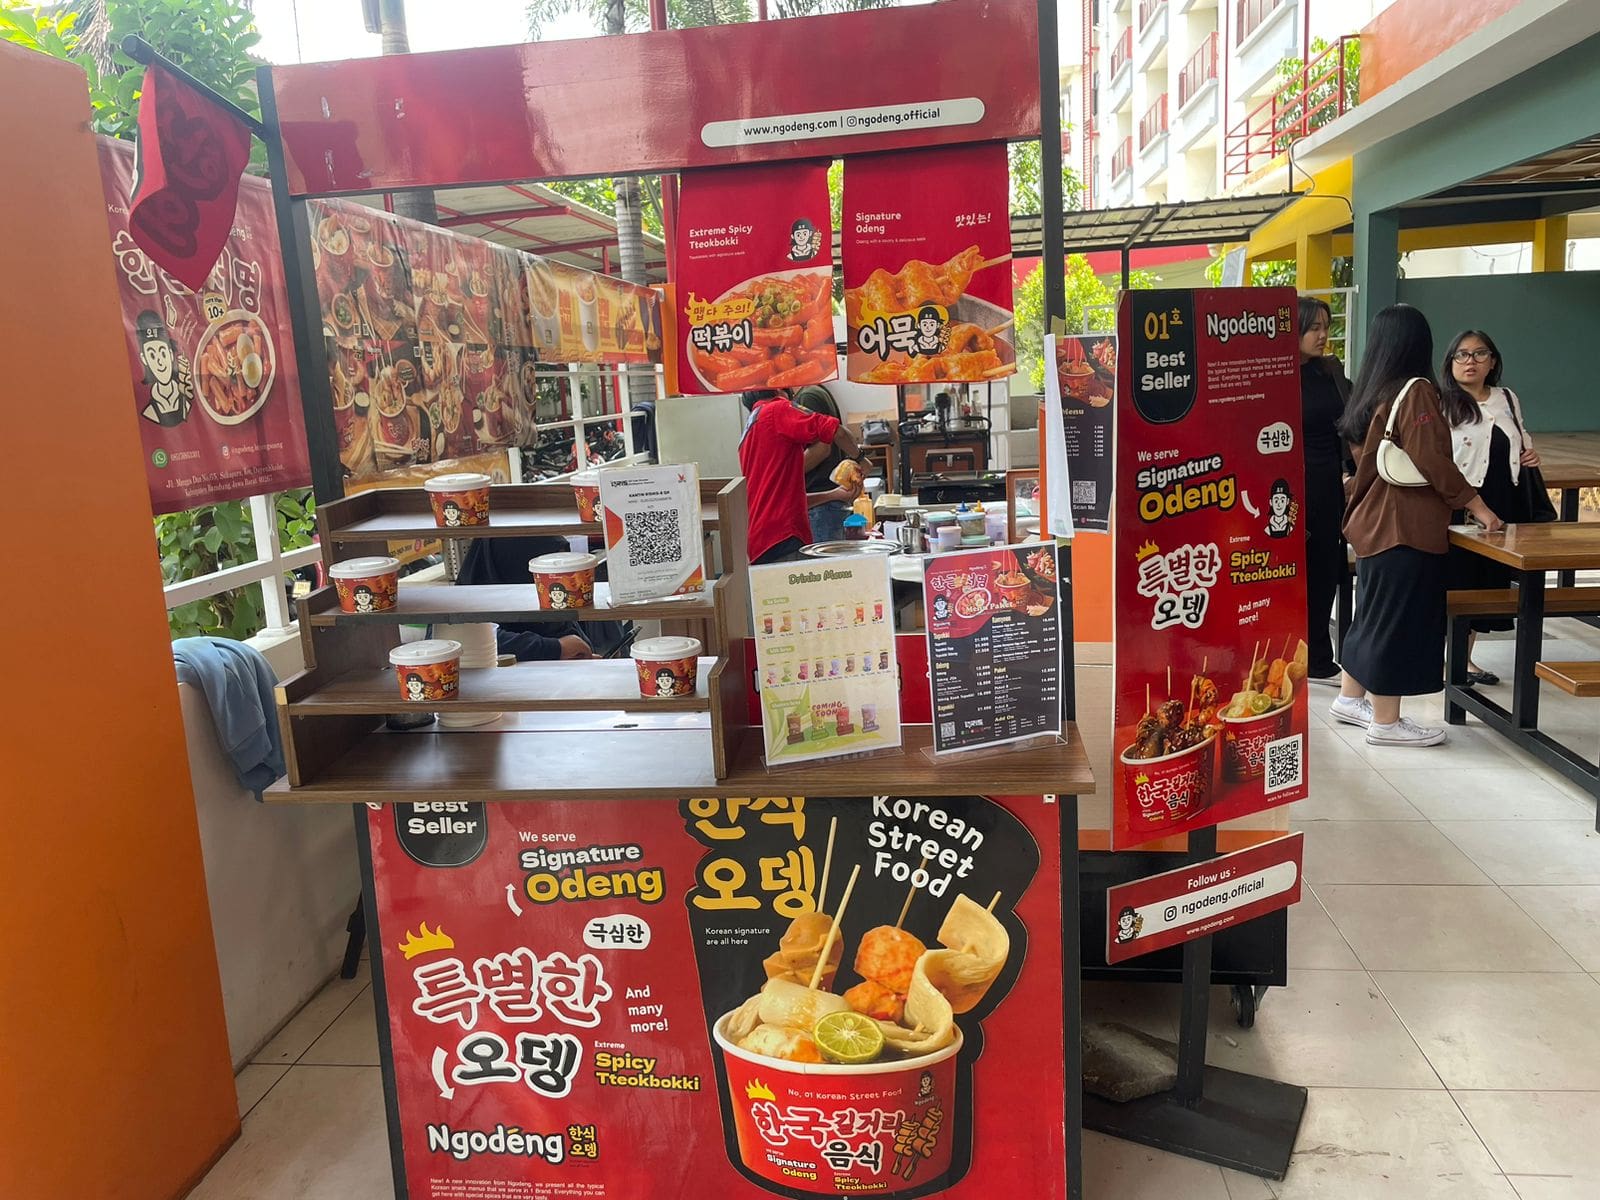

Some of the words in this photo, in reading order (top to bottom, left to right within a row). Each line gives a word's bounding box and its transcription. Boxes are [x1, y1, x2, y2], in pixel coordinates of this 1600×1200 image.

[744, 121, 837, 135] www.ngodeng.com
[858, 108, 940, 126] ngodeng.official
[856, 212, 901, 222] Signature
[955, 212, 991, 227] 맛있는!
[689, 227, 726, 237] Extreme
[729, 225, 752, 234] Spicy
[856, 225, 885, 234] Odeng
[689, 237, 738, 249] Tteokbokki
[208, 306, 224, 319] 10+
[724, 302, 751, 316] 주의!
[692, 320, 750, 350] 떡볶이
[859, 316, 918, 358] 어묵
[1146, 351, 1185, 368] Best
[1141, 373, 1191, 392] Seller
[1260, 429, 1290, 449] 극심한
[1137, 450, 1152, 462] We
[1154, 449, 1179, 461] serve
[1137, 456, 1222, 488] Signature
[1139, 477, 1236, 521] Odeng
[1230, 535, 1250, 544] Extreme
[1138, 543, 1221, 596] 특별한
[1231, 551, 1270, 572] Spicy
[823, 569, 852, 581] Menu
[1230, 566, 1296, 584] Tteokbokki
[990, 602, 1013, 610] Paket
[1153, 590, 1207, 631] 오뎅
[1239, 603, 1252, 613] And
[1253, 598, 1270, 611] many
[1238, 612, 1259, 626] more!
[812, 701, 842, 710] COMING
[815, 709, 837, 717] SOON
[412, 802, 469, 813] Best
[408, 817, 477, 834] Seller
[872, 794, 985, 852] Korean
[519, 831, 538, 842] We
[541, 833, 576, 842] serve
[521, 845, 641, 871] Signature
[868, 821, 975, 880] Street
[693, 845, 816, 918] 오뎅
[874, 852, 952, 898] Food
[1188, 872, 1218, 890] Follow
[1220, 870, 1231, 878] us
[526, 870, 663, 902] Odeng
[1182, 878, 1264, 914] ngodeng.official
[734, 928, 770, 936] signature
[1187, 915, 1235, 935] www.ngodeng.com
[588, 922, 645, 945] 극심한
[413, 947, 612, 1029] 특별한
[625, 986, 650, 999] And
[628, 1003, 663, 1019] many
[630, 1019, 669, 1033] more!
[594, 1041, 625, 1050] Extreme
[453, 1032, 583, 1098] 오뎅
[595, 1053, 656, 1073] Spicy
[596, 1072, 700, 1091] Tteokbokki
[788, 1088, 802, 1098] No.
[816, 1092, 847, 1100] Korean
[850, 1092, 879, 1100] Street
[883, 1088, 902, 1097] Food
[568, 1125, 595, 1141] 한식
[570, 1143, 597, 1158] 오뎅
[822, 1140, 883, 1174] 음식
[767, 1154, 816, 1169] Signature
[782, 1168, 817, 1180] Odeng
[835, 1176, 860, 1185] Spicy
[835, 1182, 887, 1190] Tteokbokki
